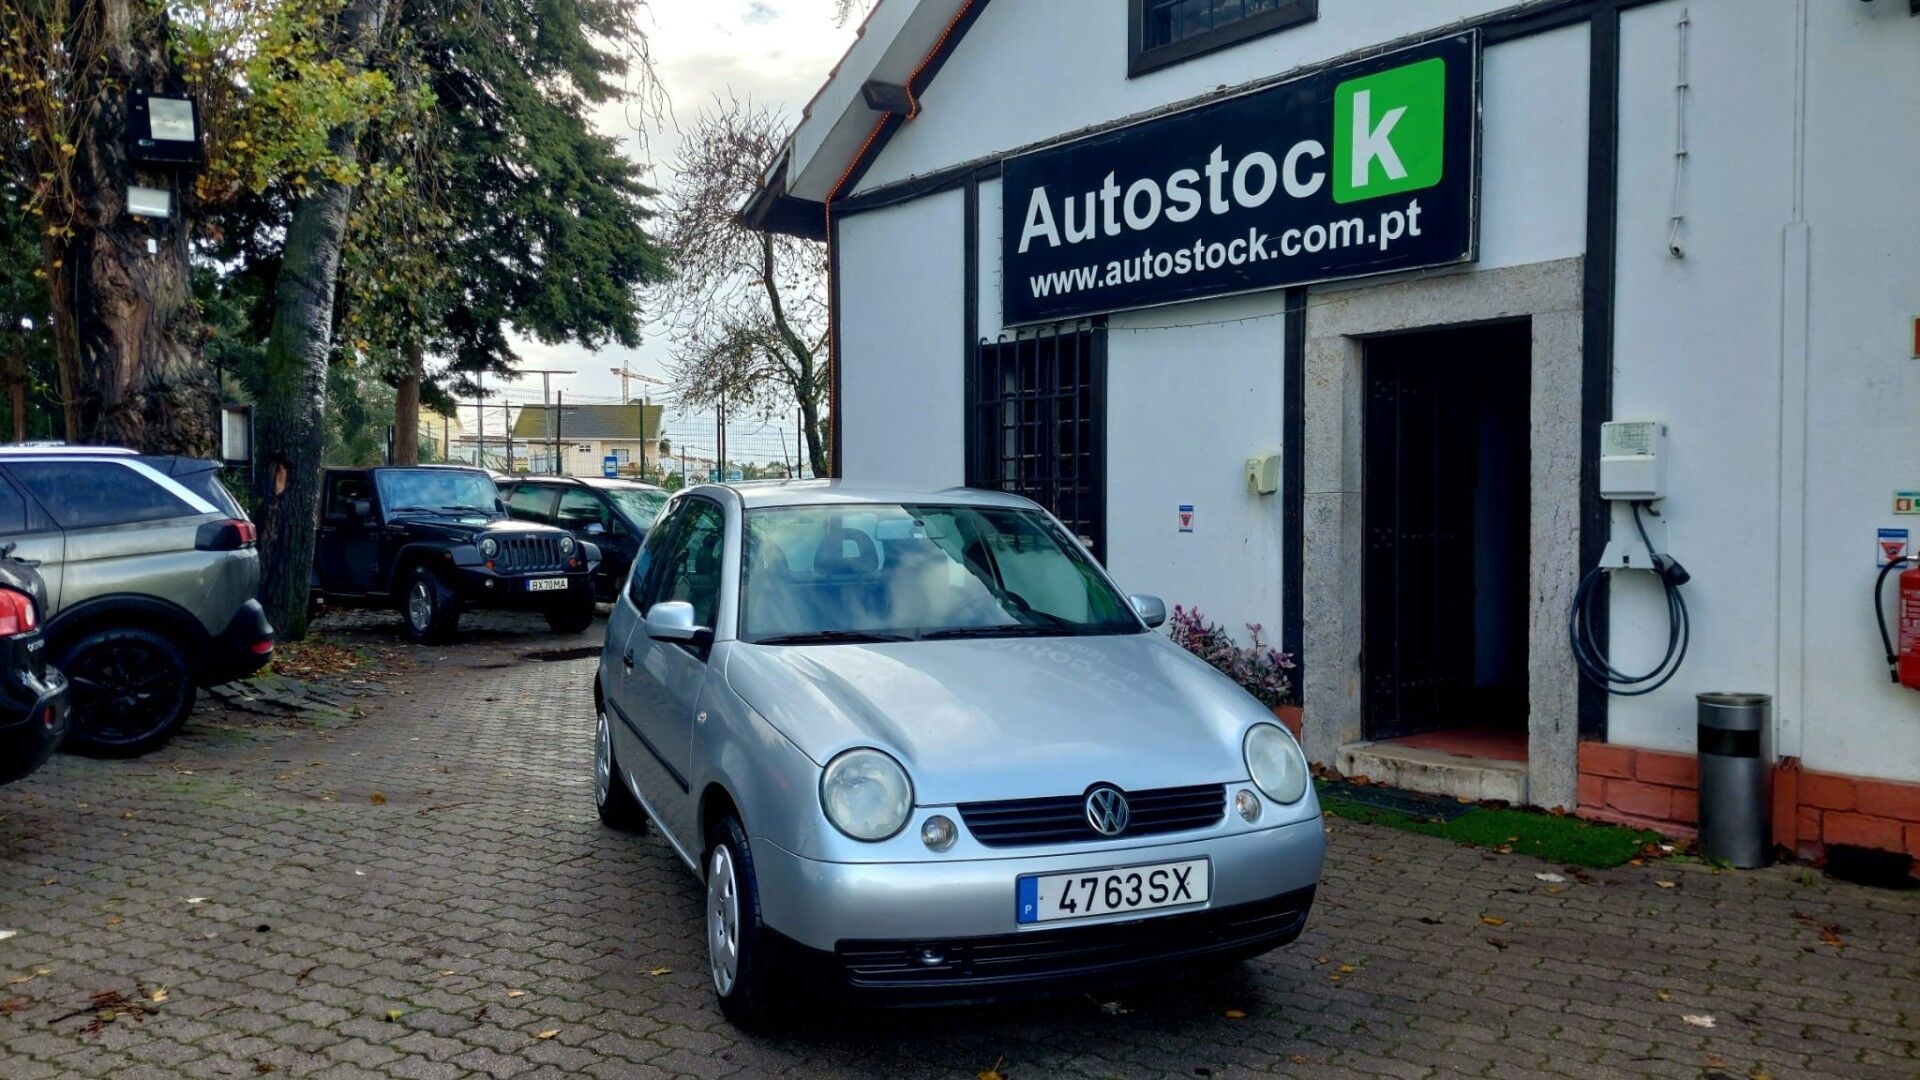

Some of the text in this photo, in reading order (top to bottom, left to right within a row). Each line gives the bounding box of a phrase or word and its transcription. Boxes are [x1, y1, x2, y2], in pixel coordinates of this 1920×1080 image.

[1018, 89, 1408, 254] Autostock
[1030, 199, 1422, 298] www.autostock.com.pt
[1058, 866, 1193, 914] 4763SX
